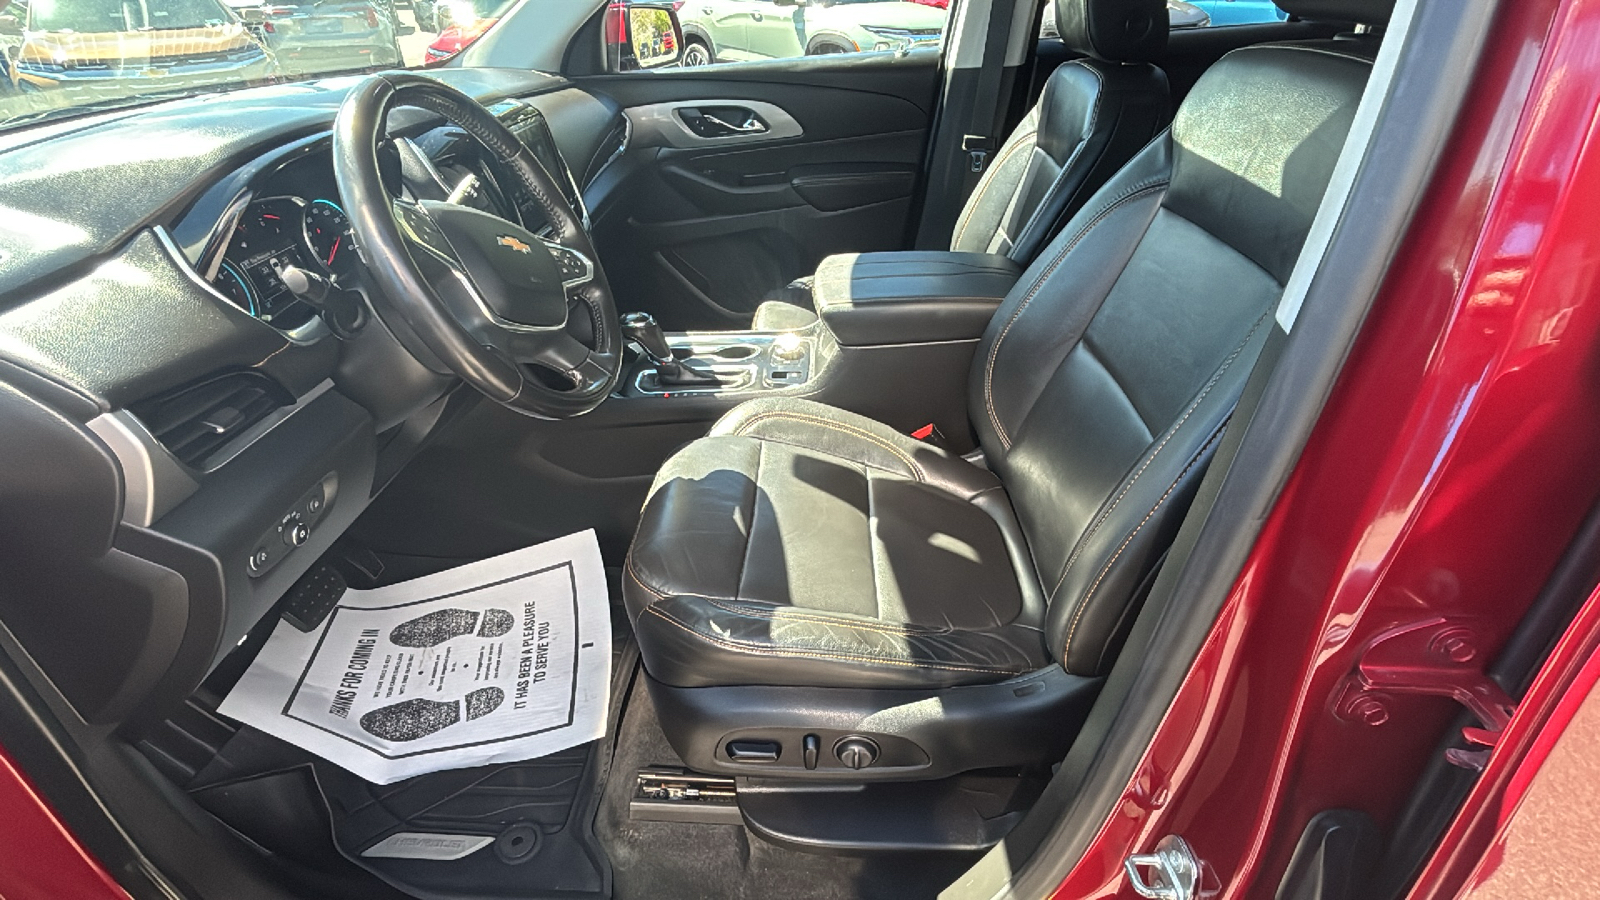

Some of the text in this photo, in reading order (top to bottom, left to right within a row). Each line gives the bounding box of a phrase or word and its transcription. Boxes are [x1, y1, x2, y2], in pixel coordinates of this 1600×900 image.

[522, 600, 536, 648] PLEASURE
[518, 656, 533, 679] BEEN
[533, 621, 550, 684] TO SERVE YOU
[329, 628, 380, 720] THANKS FOR COMING IN
[515, 680, 530, 699] HAS
[513, 701, 527, 710] IT
